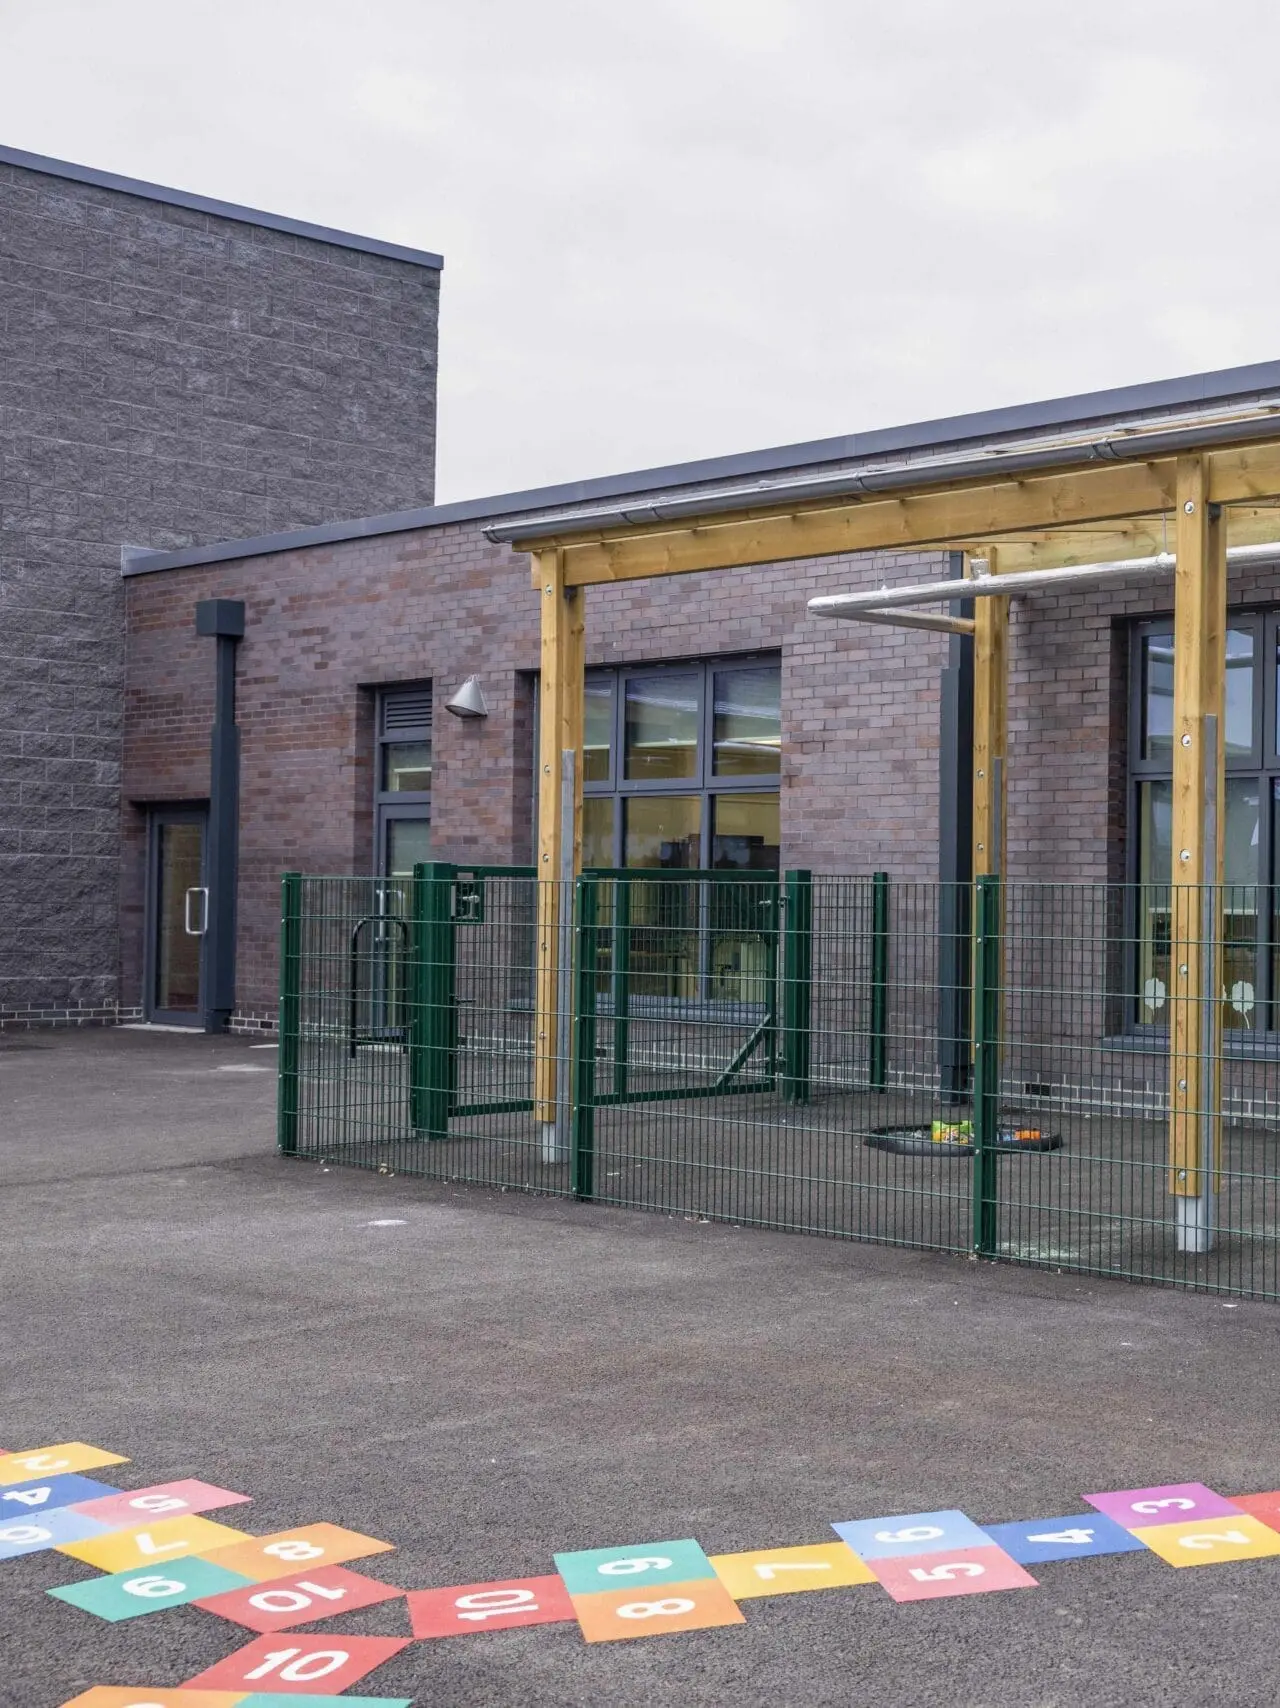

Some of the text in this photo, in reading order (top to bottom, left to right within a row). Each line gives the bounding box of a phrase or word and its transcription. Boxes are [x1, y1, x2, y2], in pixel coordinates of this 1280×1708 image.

[12, 1454, 70, 1471] 2
[2, 1486, 51, 1506] 4
[129, 1494, 190, 1513] 5
[1131, 1497, 1196, 1514] 3
[135, 1532, 190, 1555] 7
[875, 1526, 944, 1544] 6
[1026, 1528, 1095, 1545] 4
[1178, 1530, 1250, 1550] 2
[263, 1541, 325, 1561] 8
[597, 1557, 673, 1576] 9
[753, 1562, 832, 1580] 7
[911, 1562, 986, 1582] 5
[122, 1575, 186, 1598] 9
[249, 1581, 347, 1612] 10
[455, 1589, 539, 1621] 10
[616, 1598, 695, 1619] 8
[244, 1648, 349, 1681] 10
